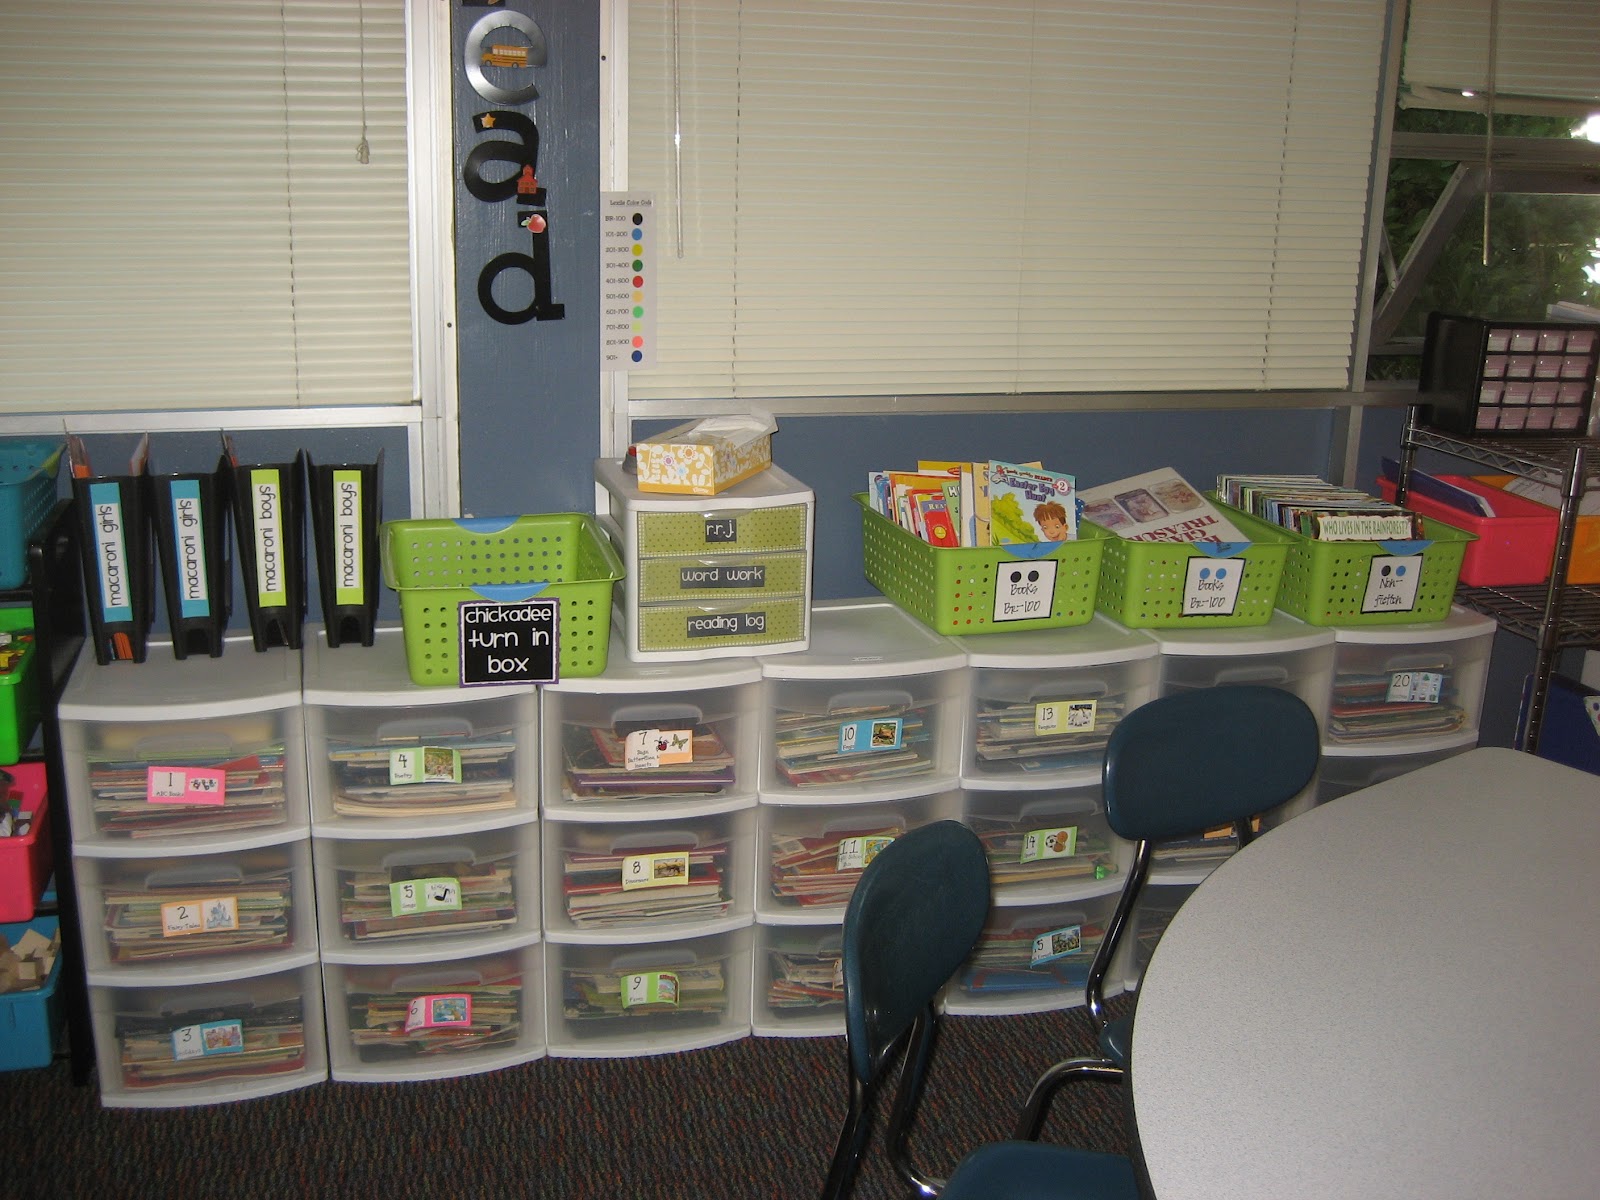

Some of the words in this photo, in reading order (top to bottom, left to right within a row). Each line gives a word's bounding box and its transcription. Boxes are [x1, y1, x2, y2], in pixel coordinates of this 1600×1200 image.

[1008, 477, 1038, 491] Easter
[1038, 483, 1055, 497] Egg
[1059, 481, 1066, 491] 2
[259, 485, 276, 519] boys
[340, 483, 357, 516] boys
[1024, 490, 1047, 503] Hunt
[98, 505, 119, 533] girls
[178, 499, 198, 527] girls
[1127, 514, 1219, 541] TREASUR
[1322, 520, 1338, 535] WHO
[1338, 520, 1353, 535] LIVES
[1353, 520, 1360, 535] IN
[1361, 520, 1372, 535] THE
[1372, 520, 1408, 535] RAINFOREST?
[260, 527, 276, 592] macaroni
[340, 524, 354, 587] macaroni
[102, 542, 122, 606] macaroni
[181, 536, 200, 599] macaroni
[681, 568, 719, 582] word
[726, 566, 763, 581] work
[465, 605, 552, 624] chickadee
[687, 615, 738, 632] reading
[745, 613, 765, 631] log
[468, 629, 519, 649] turn
[531, 627, 550, 647] in
[487, 654, 530, 674] box
[1392, 674, 1411, 687] 20
[1042, 707, 1054, 721] 13
[638, 731, 648, 745] 7
[844, 727, 855, 741] 10
[398, 753, 408, 769] 4
[168, 772, 173, 787] 1
[839, 839, 859, 856] 11
[632, 861, 641, 874] 8
[403, 884, 414, 899] 5
[177, 906, 189, 920] 2
[632, 976, 642, 990] 9
[181, 1027, 192, 1042] 3
